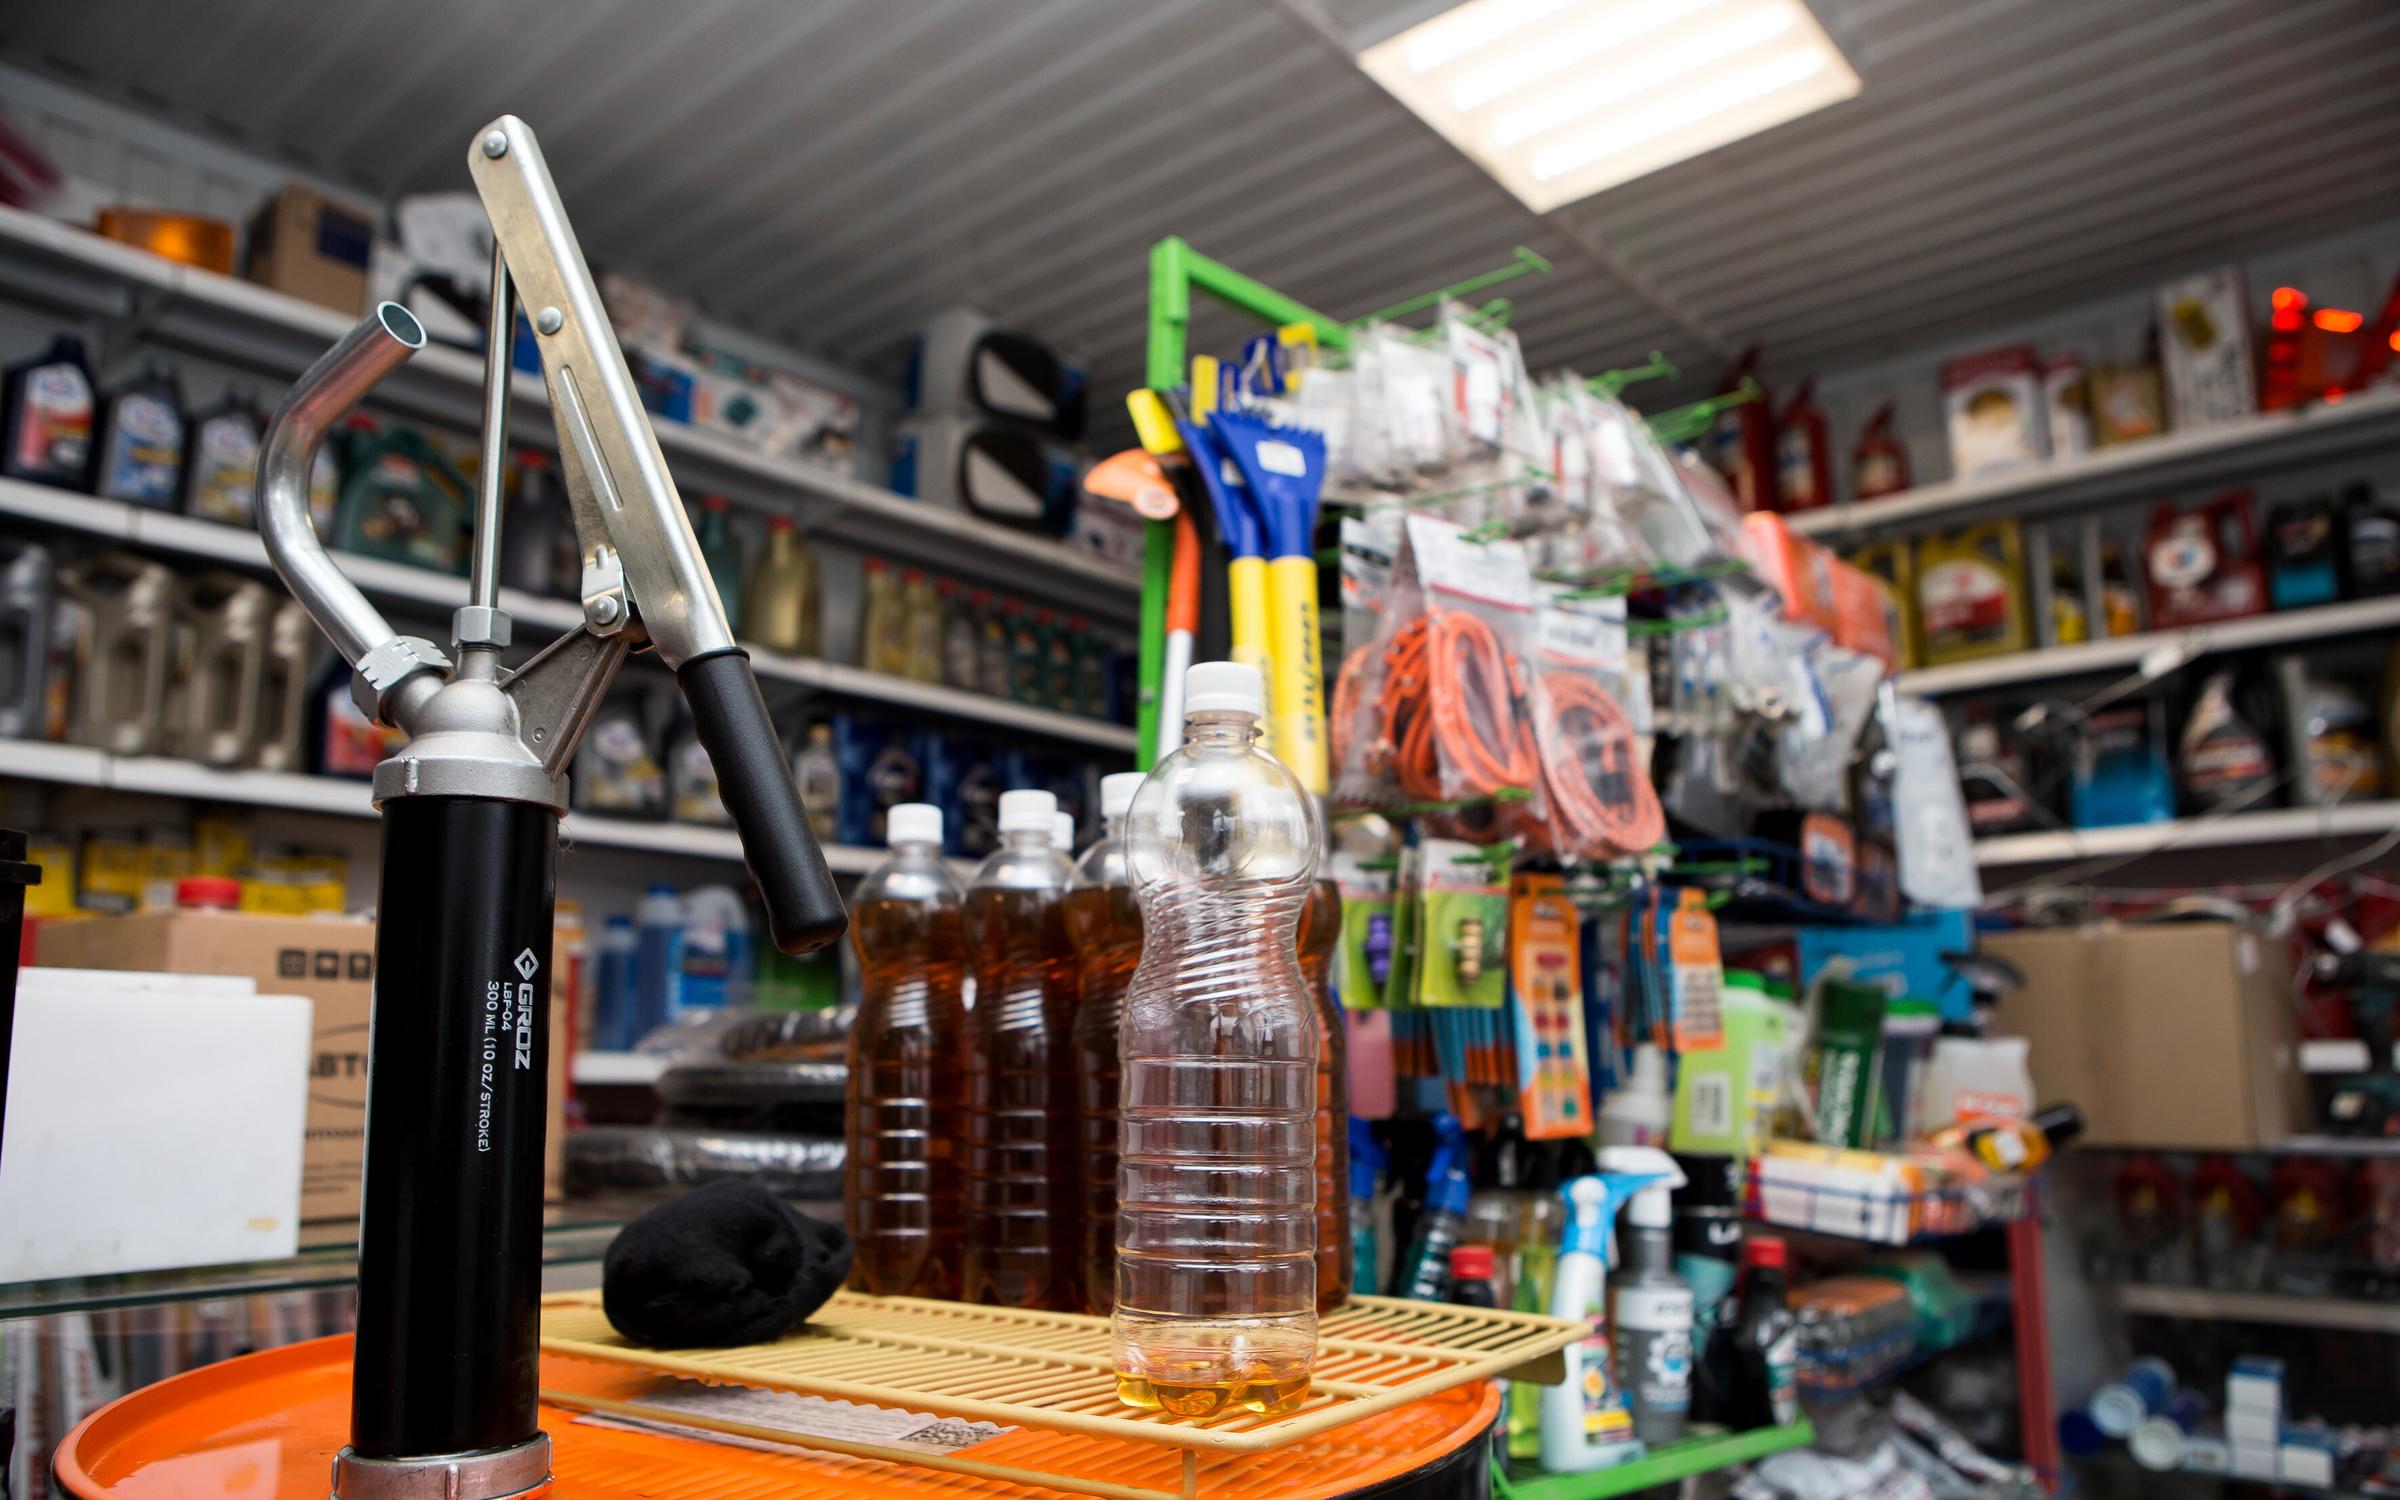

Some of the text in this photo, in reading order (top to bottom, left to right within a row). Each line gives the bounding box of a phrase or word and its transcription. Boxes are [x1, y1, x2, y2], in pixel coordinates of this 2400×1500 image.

[477, 981, 500, 1152] 300 ML (10 OZ/STROKE)
[514, 982, 534, 1070] GROZ
